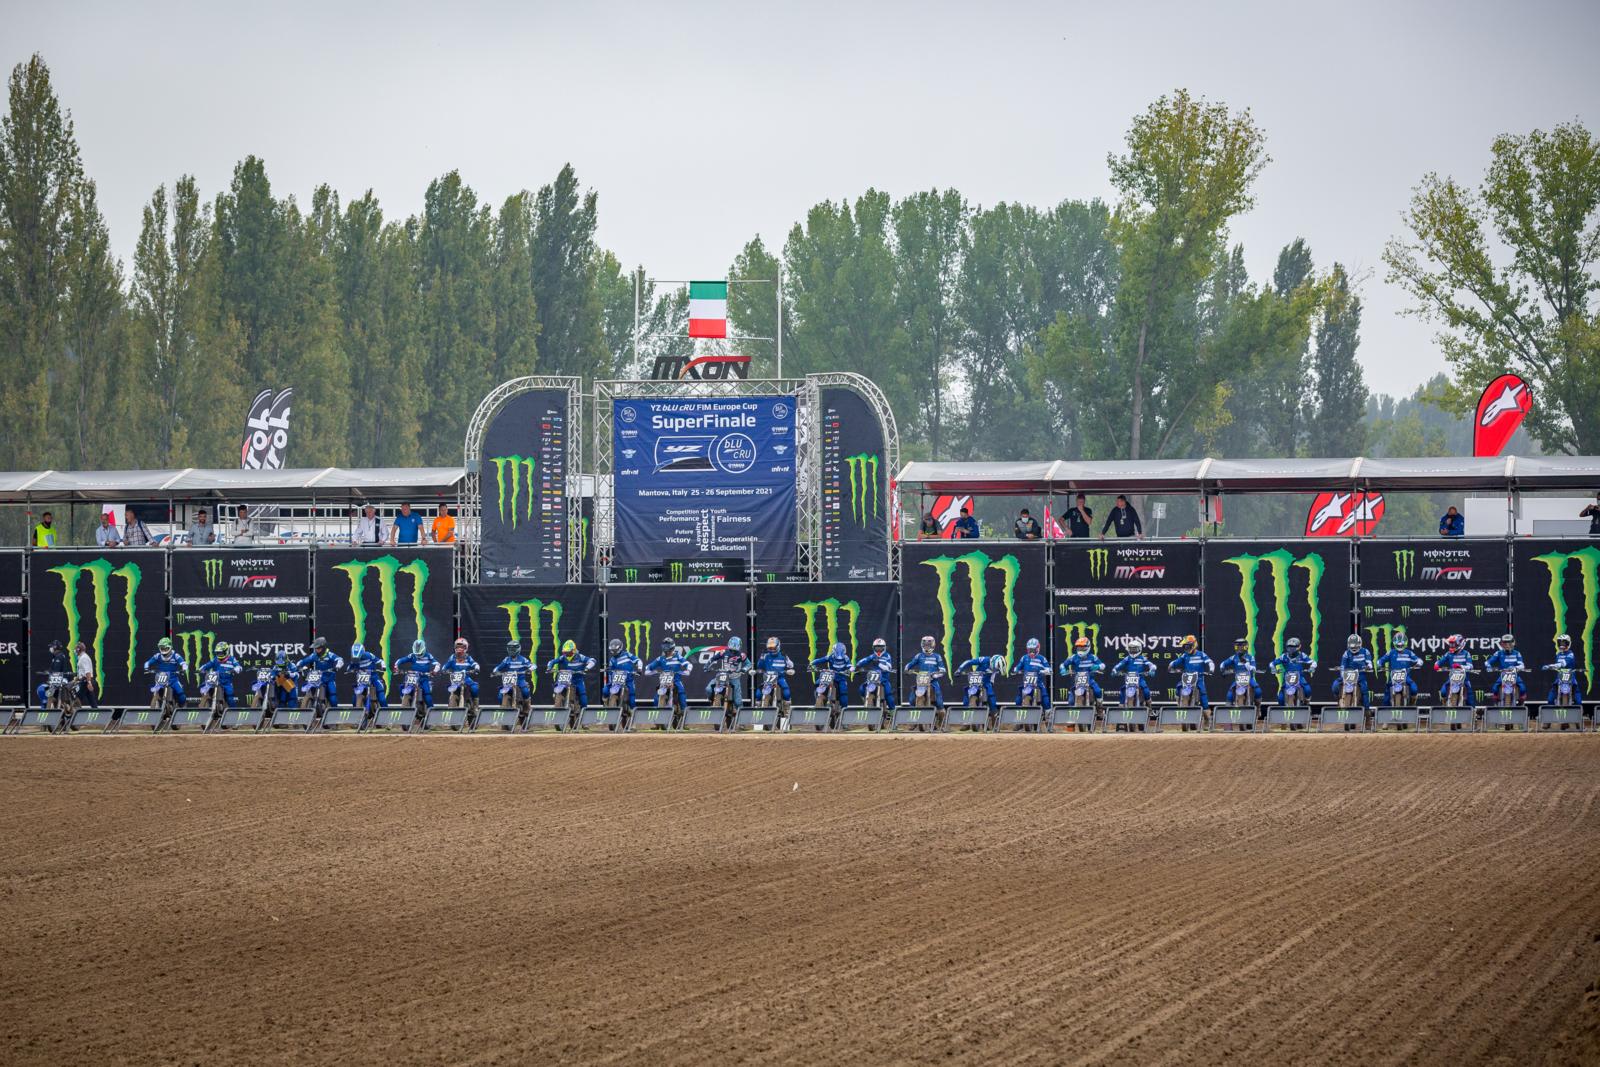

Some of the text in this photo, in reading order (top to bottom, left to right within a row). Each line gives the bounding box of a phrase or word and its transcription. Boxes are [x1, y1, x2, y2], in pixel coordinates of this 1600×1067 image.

[651, 404, 661, 412] YZ
[697, 403, 711, 411] FIM
[713, 403, 741, 411] Europe
[742, 402, 758, 411] Cup
[652, 413, 756, 432] SuperFinale
[672, 489, 688, 497] Italy
[716, 488, 754, 496] September
[701, 508, 711, 551] Respect
[1117, 548, 1163, 557] MONSTER
[1423, 549, 1470, 558] MONSTER
[664, 619, 732, 632] MONSTER
[1104, 633, 1183, 650] MONSTE
[1187, 675, 1193, 683] 9
